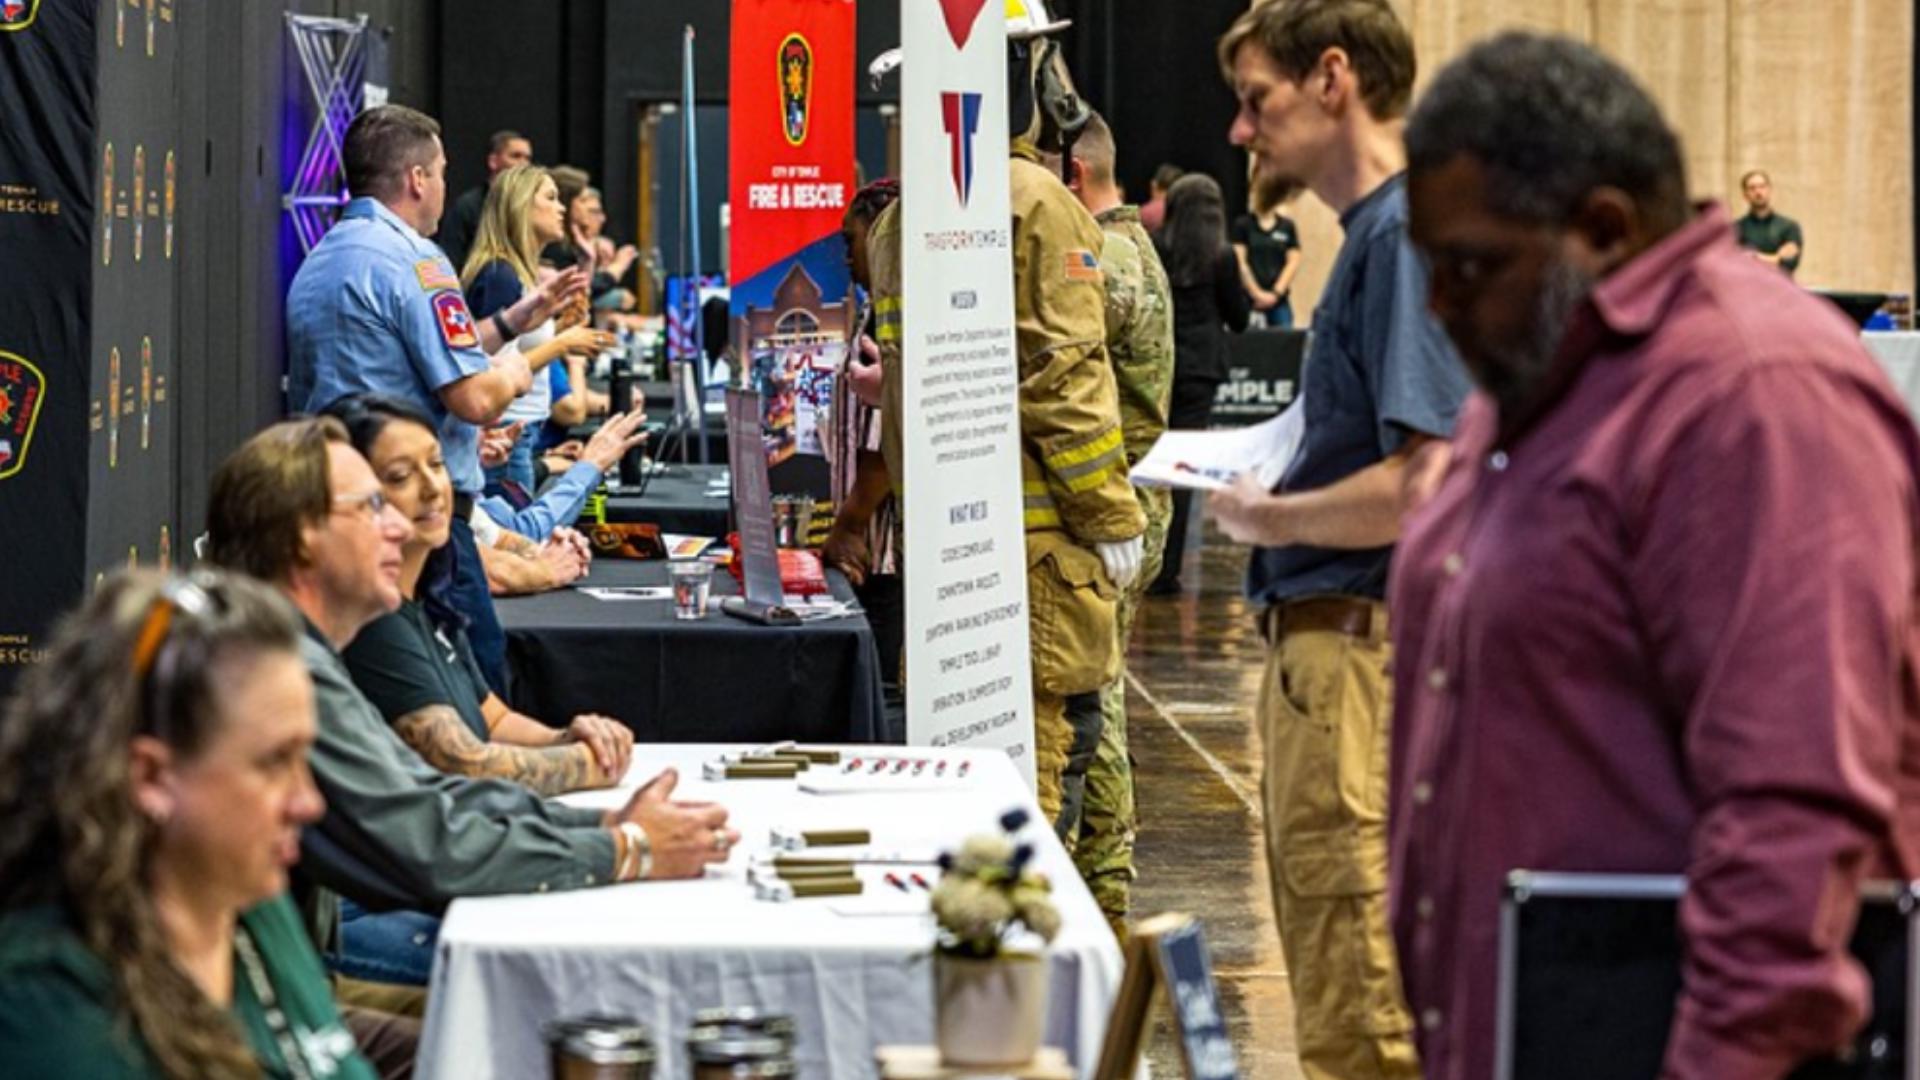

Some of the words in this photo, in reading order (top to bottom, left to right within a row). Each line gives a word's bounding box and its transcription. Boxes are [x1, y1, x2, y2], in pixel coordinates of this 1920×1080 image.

[749, 184, 779, 209] FIRE
[793, 184, 845, 208] RESCUE
[1213, 379, 1295, 403] MPLE
